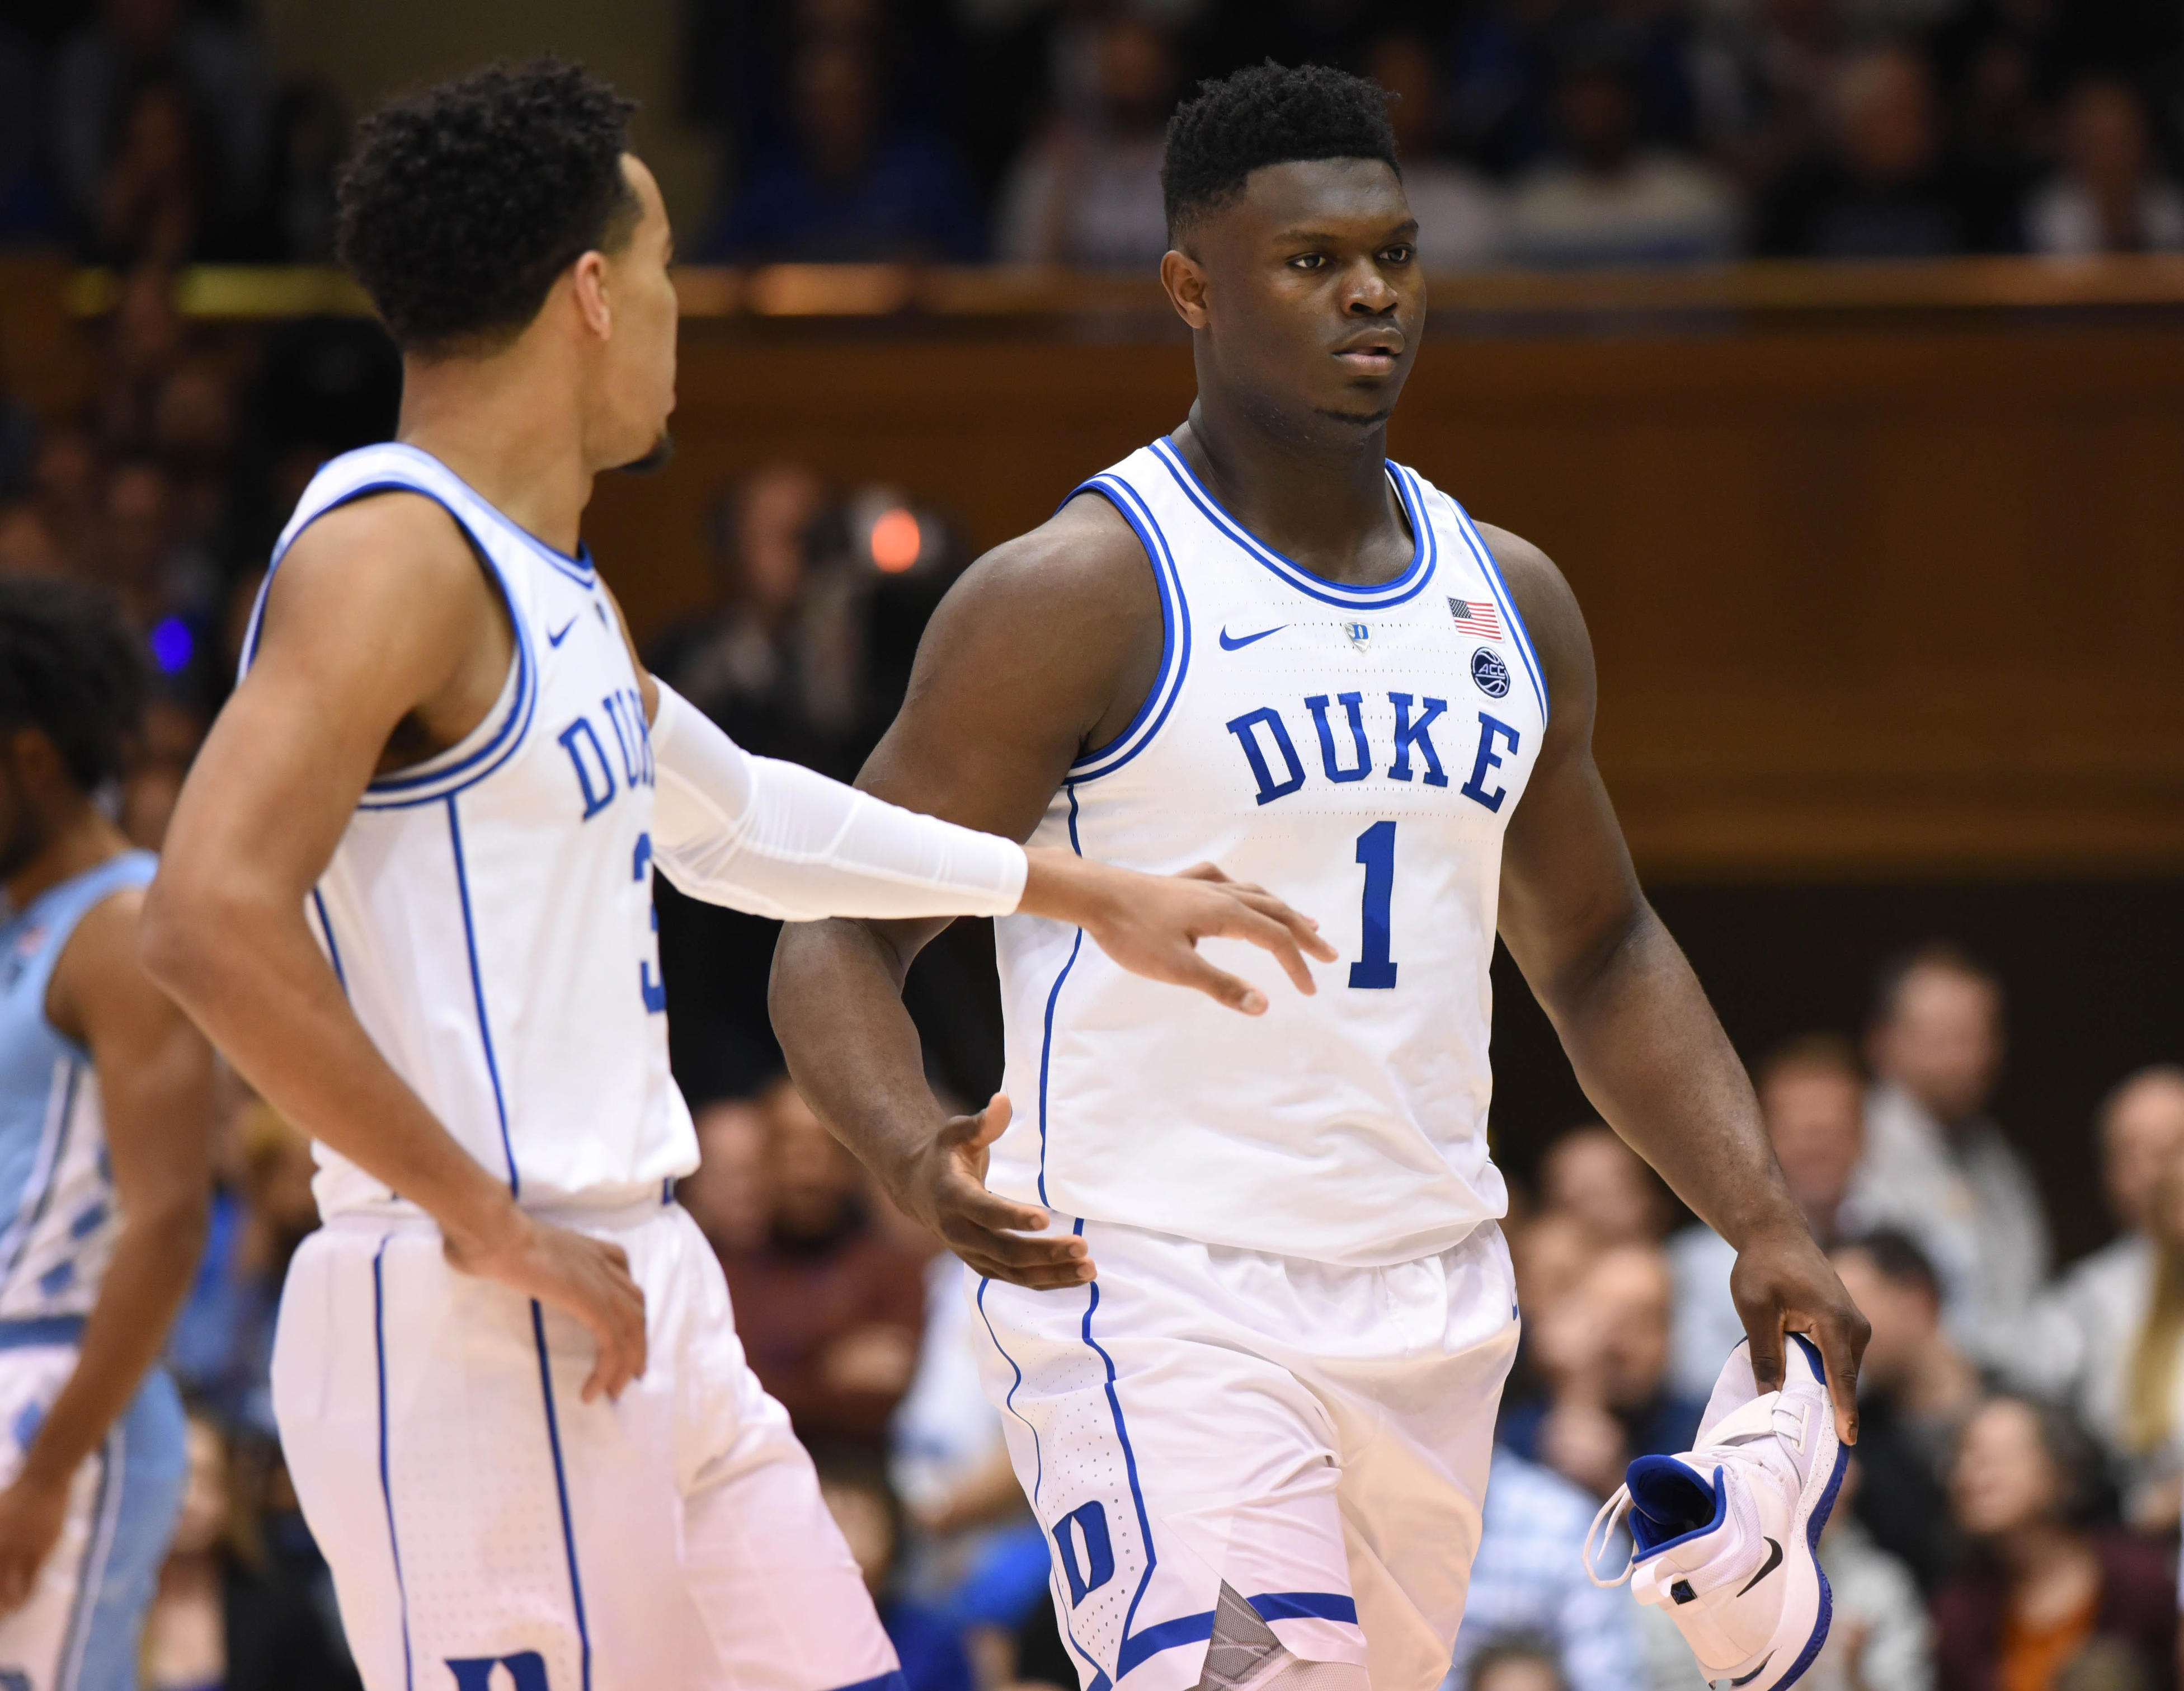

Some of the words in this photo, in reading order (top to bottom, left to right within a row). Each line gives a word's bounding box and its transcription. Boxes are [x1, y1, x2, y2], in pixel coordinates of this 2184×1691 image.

[1478, 663, 1505, 677] ACC
[1225, 692, 1520, 813] DUKE
[1348, 821, 1397, 989] 1
[1051, 1500, 1115, 1610] D
